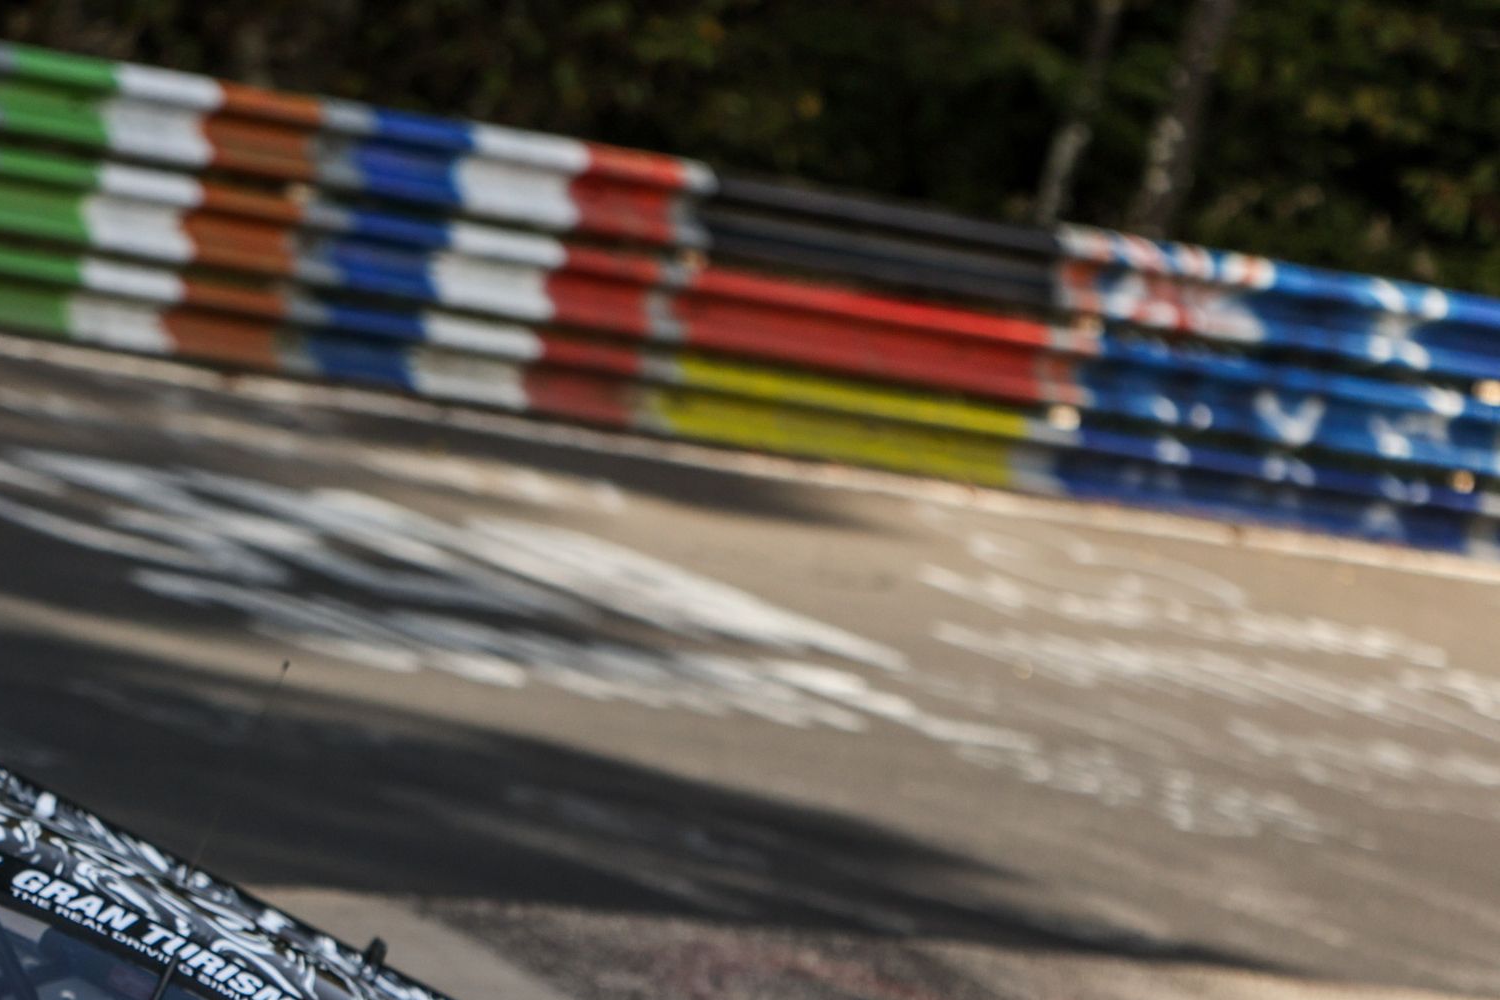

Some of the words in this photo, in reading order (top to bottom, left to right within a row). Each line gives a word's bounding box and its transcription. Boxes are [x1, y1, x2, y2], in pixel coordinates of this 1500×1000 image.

[11, 869, 139, 932] GRAN
[11, 887, 51, 911] THE
[54, 904, 108, 935] REAL
[111, 931, 194, 977] DRIVIG
